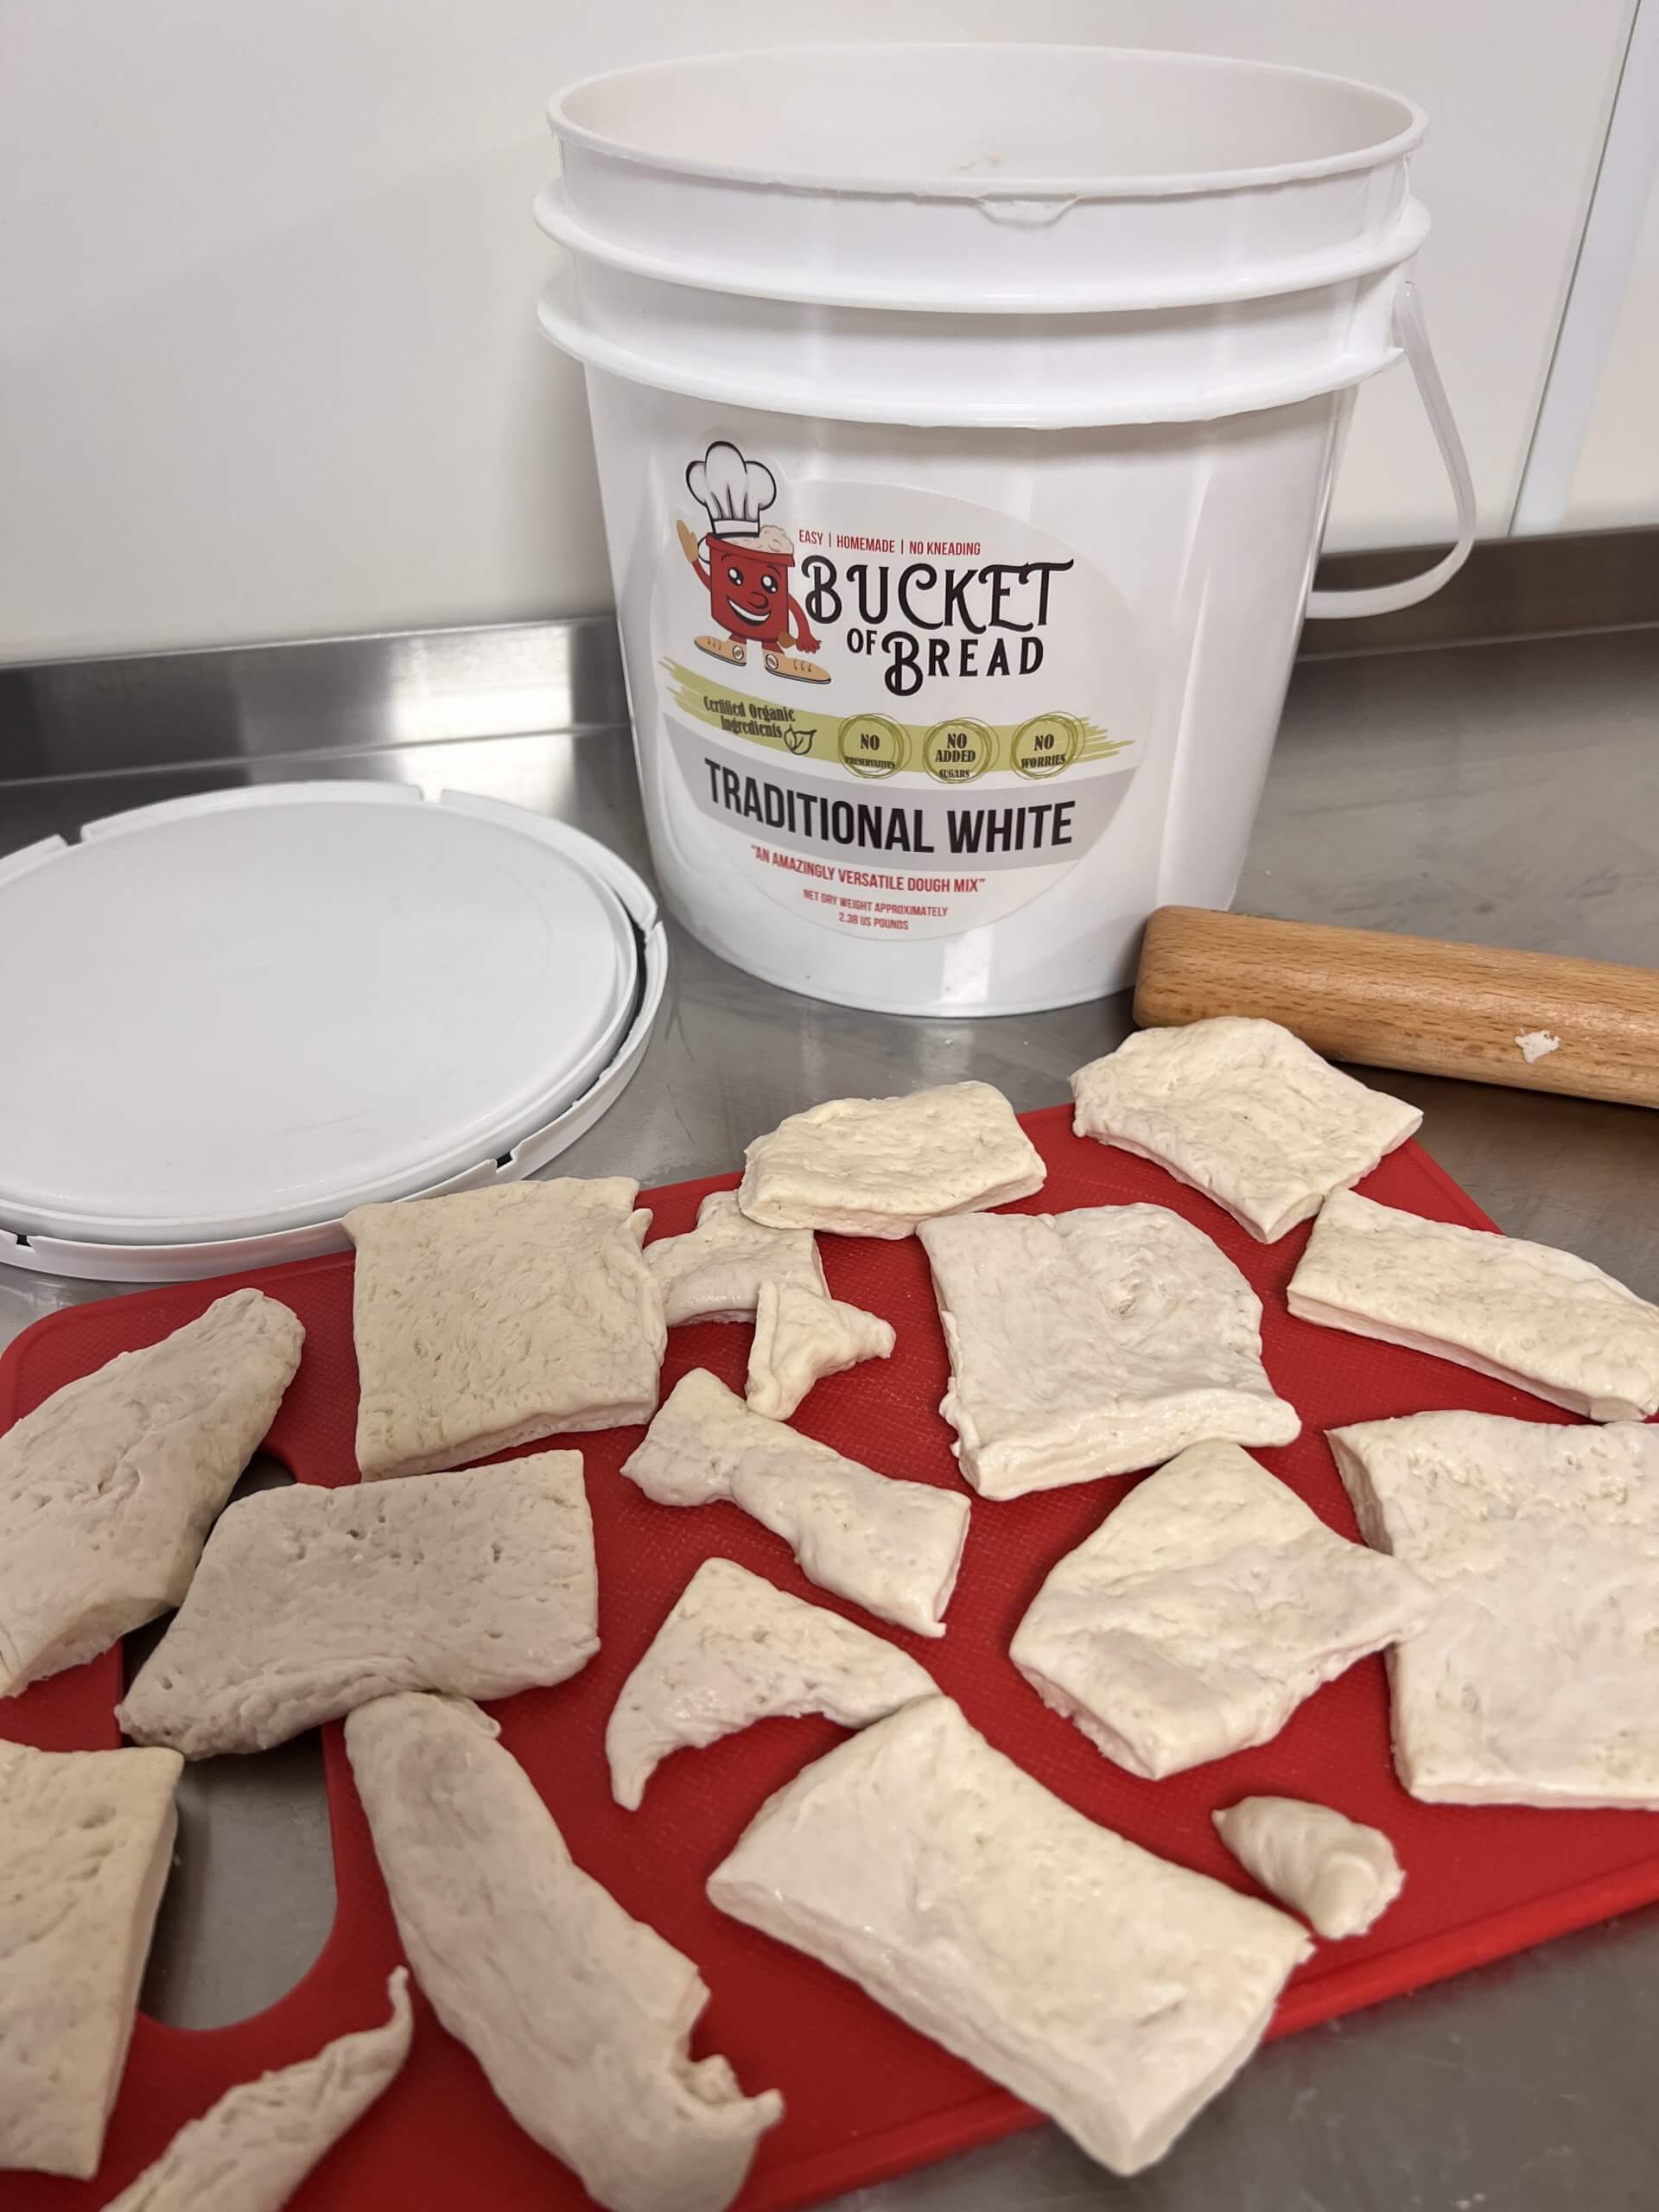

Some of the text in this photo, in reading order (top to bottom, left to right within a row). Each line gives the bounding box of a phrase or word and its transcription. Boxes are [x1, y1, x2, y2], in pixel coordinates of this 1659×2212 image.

[799, 530, 982, 556] EASY HOMEMADE NO KNEADING
[801, 555, 1074, 634] BUCKET
[847, 628, 1044, 696] OF BREAD
[749, 702, 796, 722] Organic
[860, 734, 880, 751] NO
[947, 733, 968, 749] NO
[1033, 734, 1054, 751] NO
[844, 756, 895, 769] PRESERVATIVES
[935, 750, 976, 763] ADDED
[1021, 753, 1065, 770] WORRIES
[939, 769, 970, 779] SUGARS
[704, 758, 1076, 853] TRADITIONAL WHITE
[772, 852, 835, 880] AMAZINGLY
[838, 868, 904, 891] VERSATILE
[907, 877, 950, 892] DOUGH
[803, 889, 819, 901] NET
[839, 896, 873, 912] WEIGHT
[874, 901, 948, 918] APPROXIMATELY
[838, 912, 909, 930] 2.38 US POUNDS
